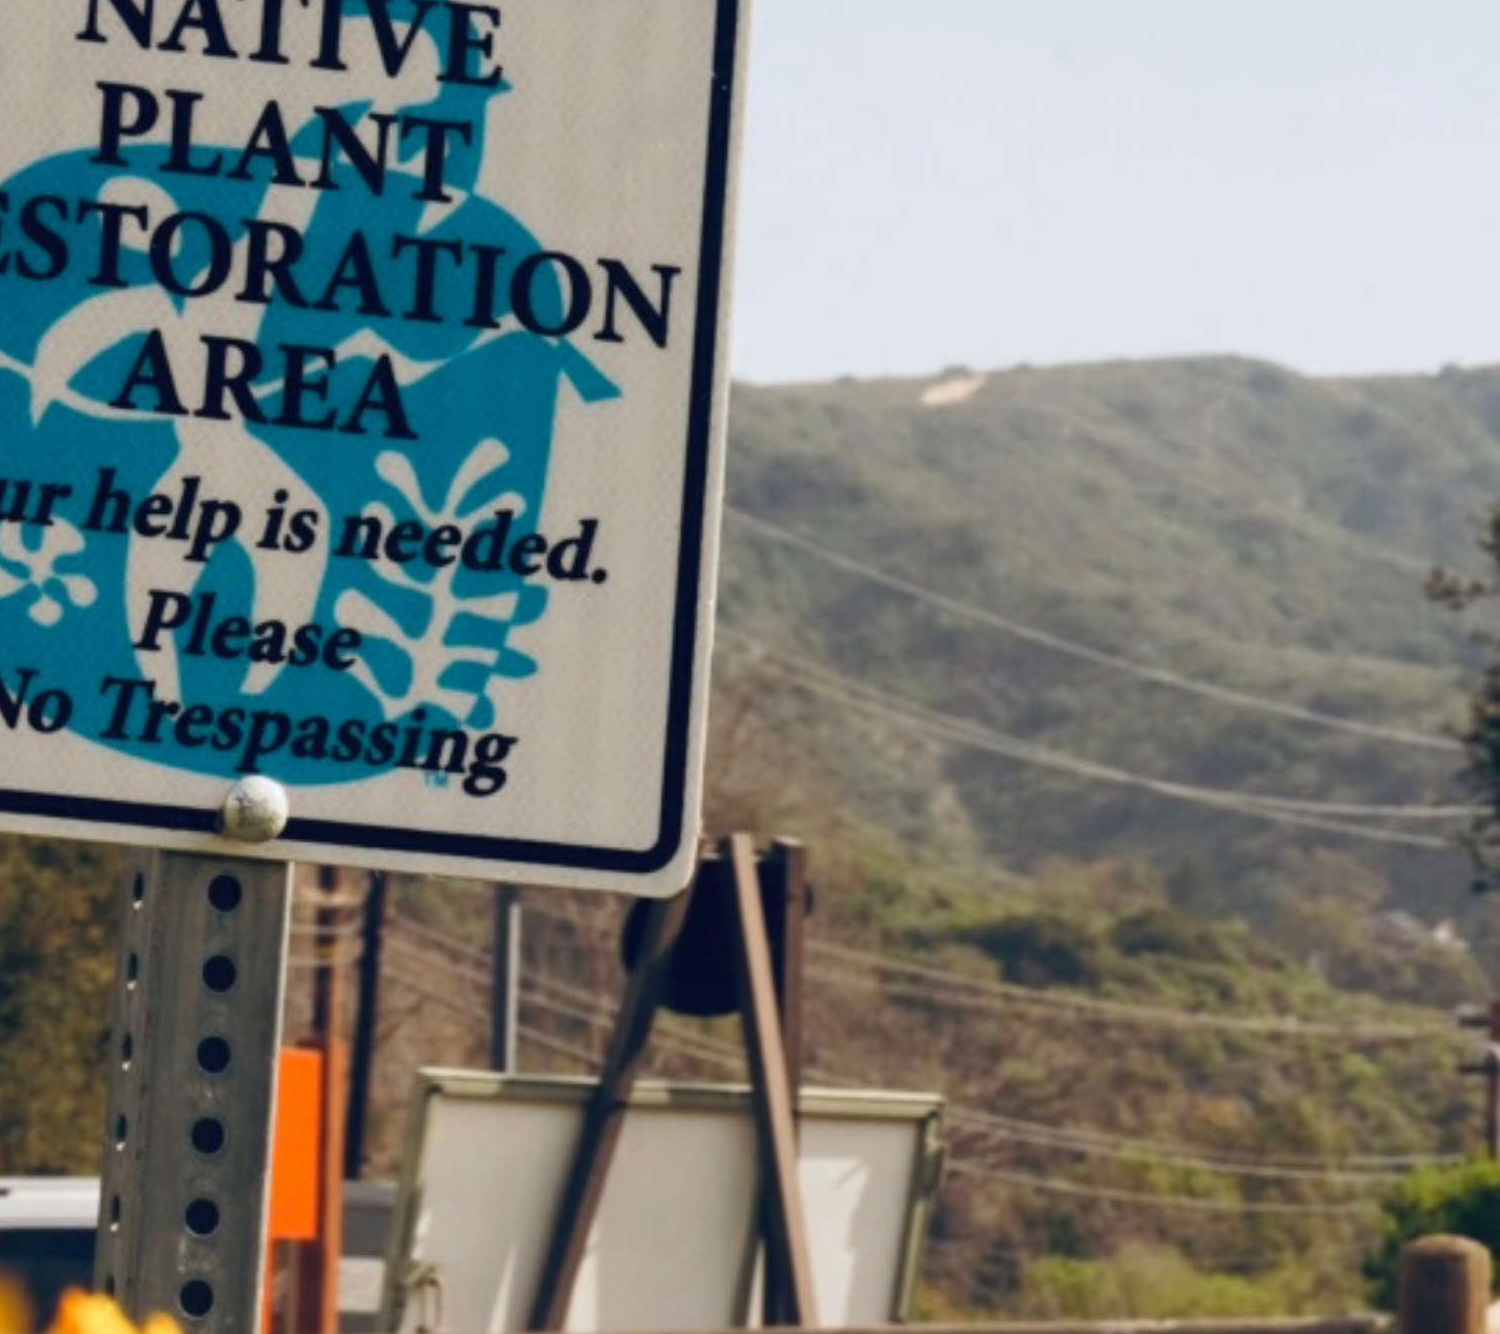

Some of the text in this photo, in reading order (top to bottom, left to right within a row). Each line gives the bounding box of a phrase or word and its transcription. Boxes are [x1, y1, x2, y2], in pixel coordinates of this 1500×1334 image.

[88, 81, 474, 204] PLANT
[108, 329, 420, 441] AREA
[81, 467, 242, 563] help
[257, 489, 318, 554] is
[331, 509, 609, 585] needed.
[132, 589, 363, 672] Please
[99, 674, 519, 797] Trespassing
